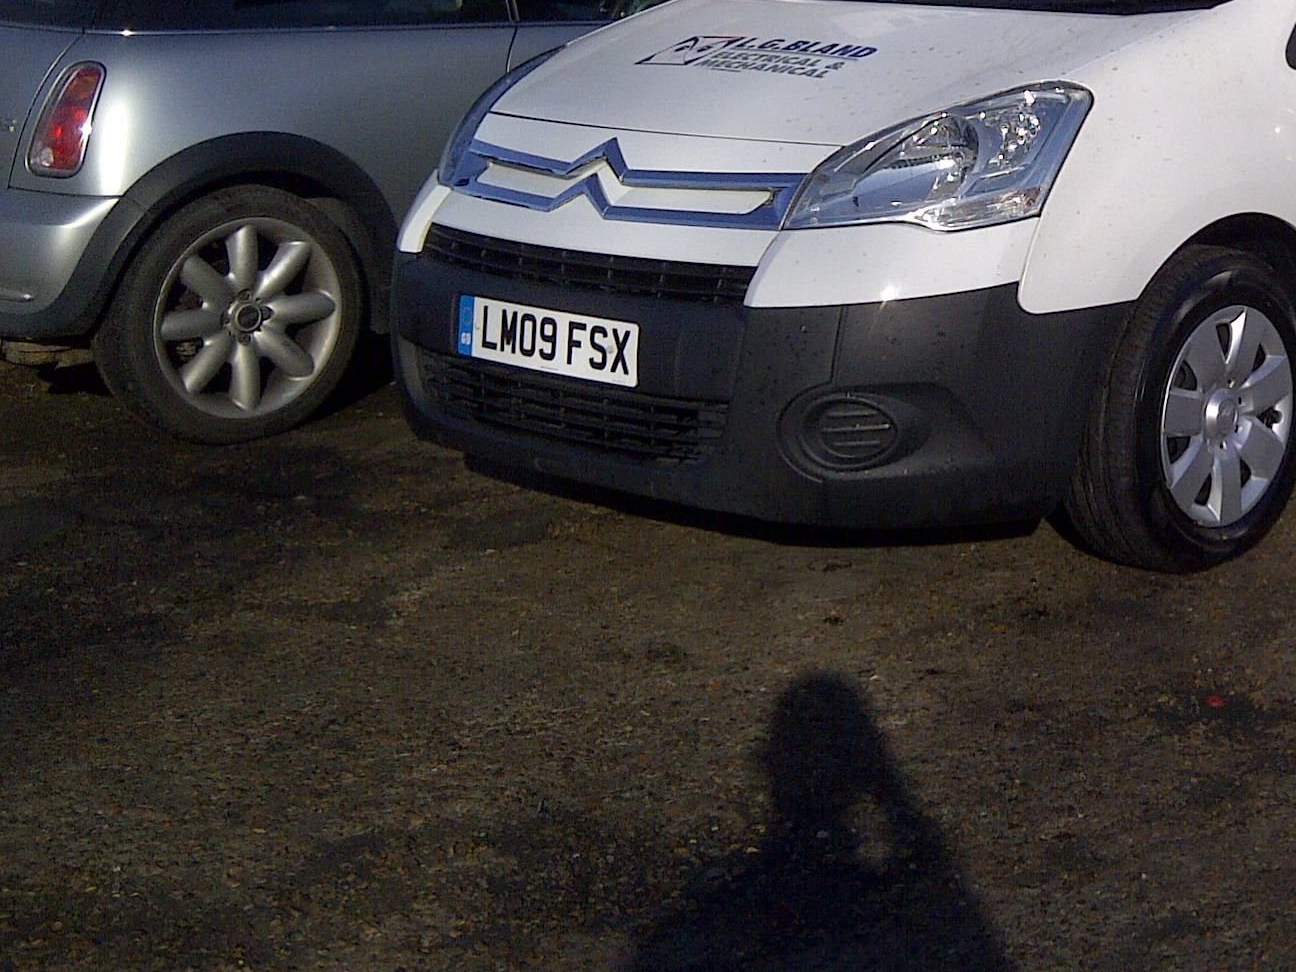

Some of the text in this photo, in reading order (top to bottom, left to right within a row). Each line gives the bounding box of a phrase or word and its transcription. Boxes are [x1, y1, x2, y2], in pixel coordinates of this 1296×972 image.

[737, 37, 877, 59] L.G.BLAND
[696, 59, 829, 78] MECHANICAL
[711, 51, 845, 70] ELECTRICAL &
[482, 305, 631, 375] LM09 FSX
